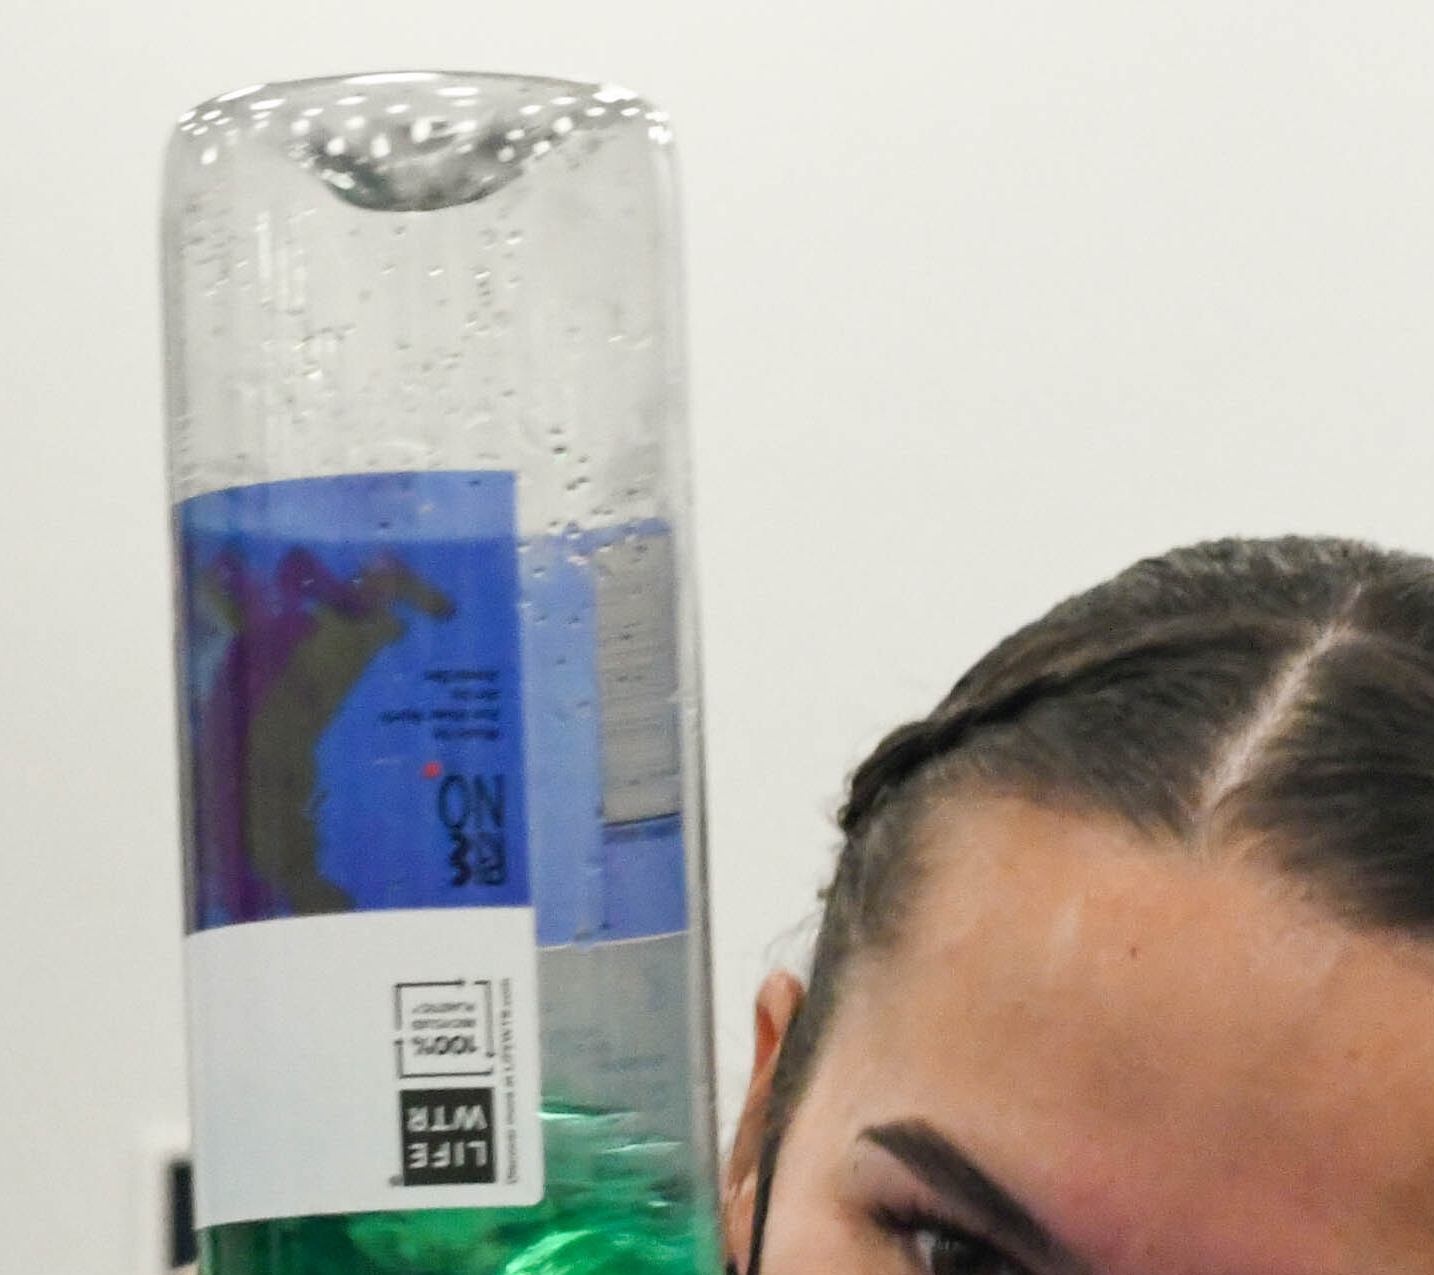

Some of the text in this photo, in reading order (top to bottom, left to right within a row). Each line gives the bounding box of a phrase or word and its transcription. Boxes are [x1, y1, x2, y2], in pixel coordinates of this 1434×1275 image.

[411, 1035, 478, 1057] 100%
[406, 1105, 488, 1134] WTR
[407, 1140, 488, 1169] LIFE
